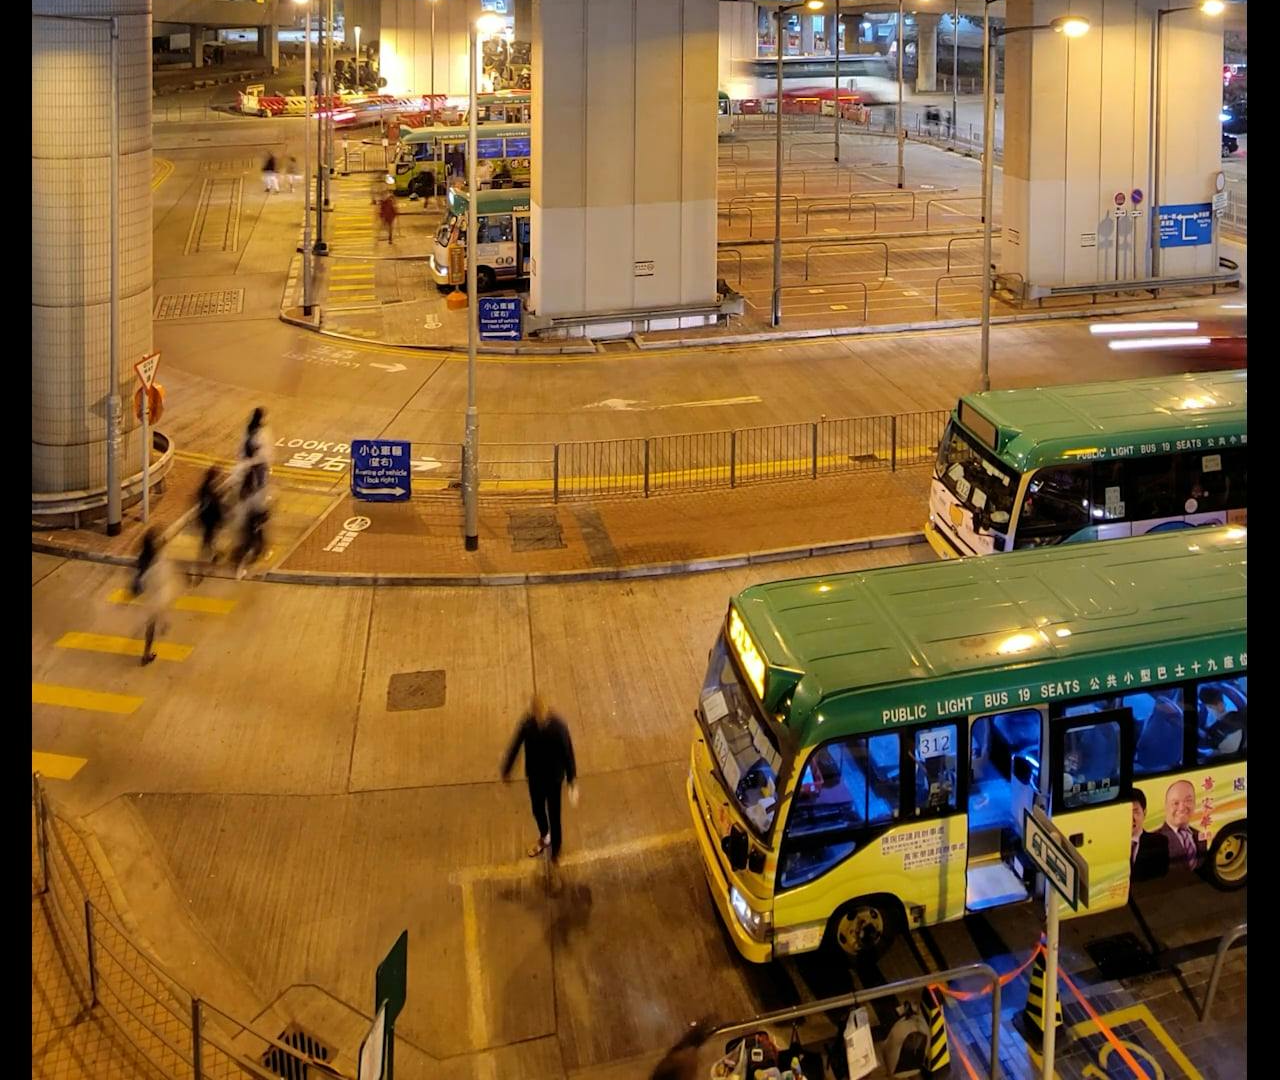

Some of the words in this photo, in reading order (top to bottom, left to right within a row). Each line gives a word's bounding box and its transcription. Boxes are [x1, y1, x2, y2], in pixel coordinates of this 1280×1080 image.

[275, 437, 332, 451] LOOK
[1110, 445, 1134, 457] LIGHT
[1141, 443, 1157, 454] BUS
[1162, 442, 1170, 451] 19
[1176, 439, 1201, 450] SEATS
[284, 451, 351, 471] 望右
[377, 468, 385, 476] of
[882, 705, 927, 724] PUBLIC
[937, 697, 974, 715] LIGHT
[984, 692, 1008, 708] BUS
[1018, 688, 1030, 702] 19
[1041, 680, 1080, 698] SEATS
[921, 735, 950, 754] 312
